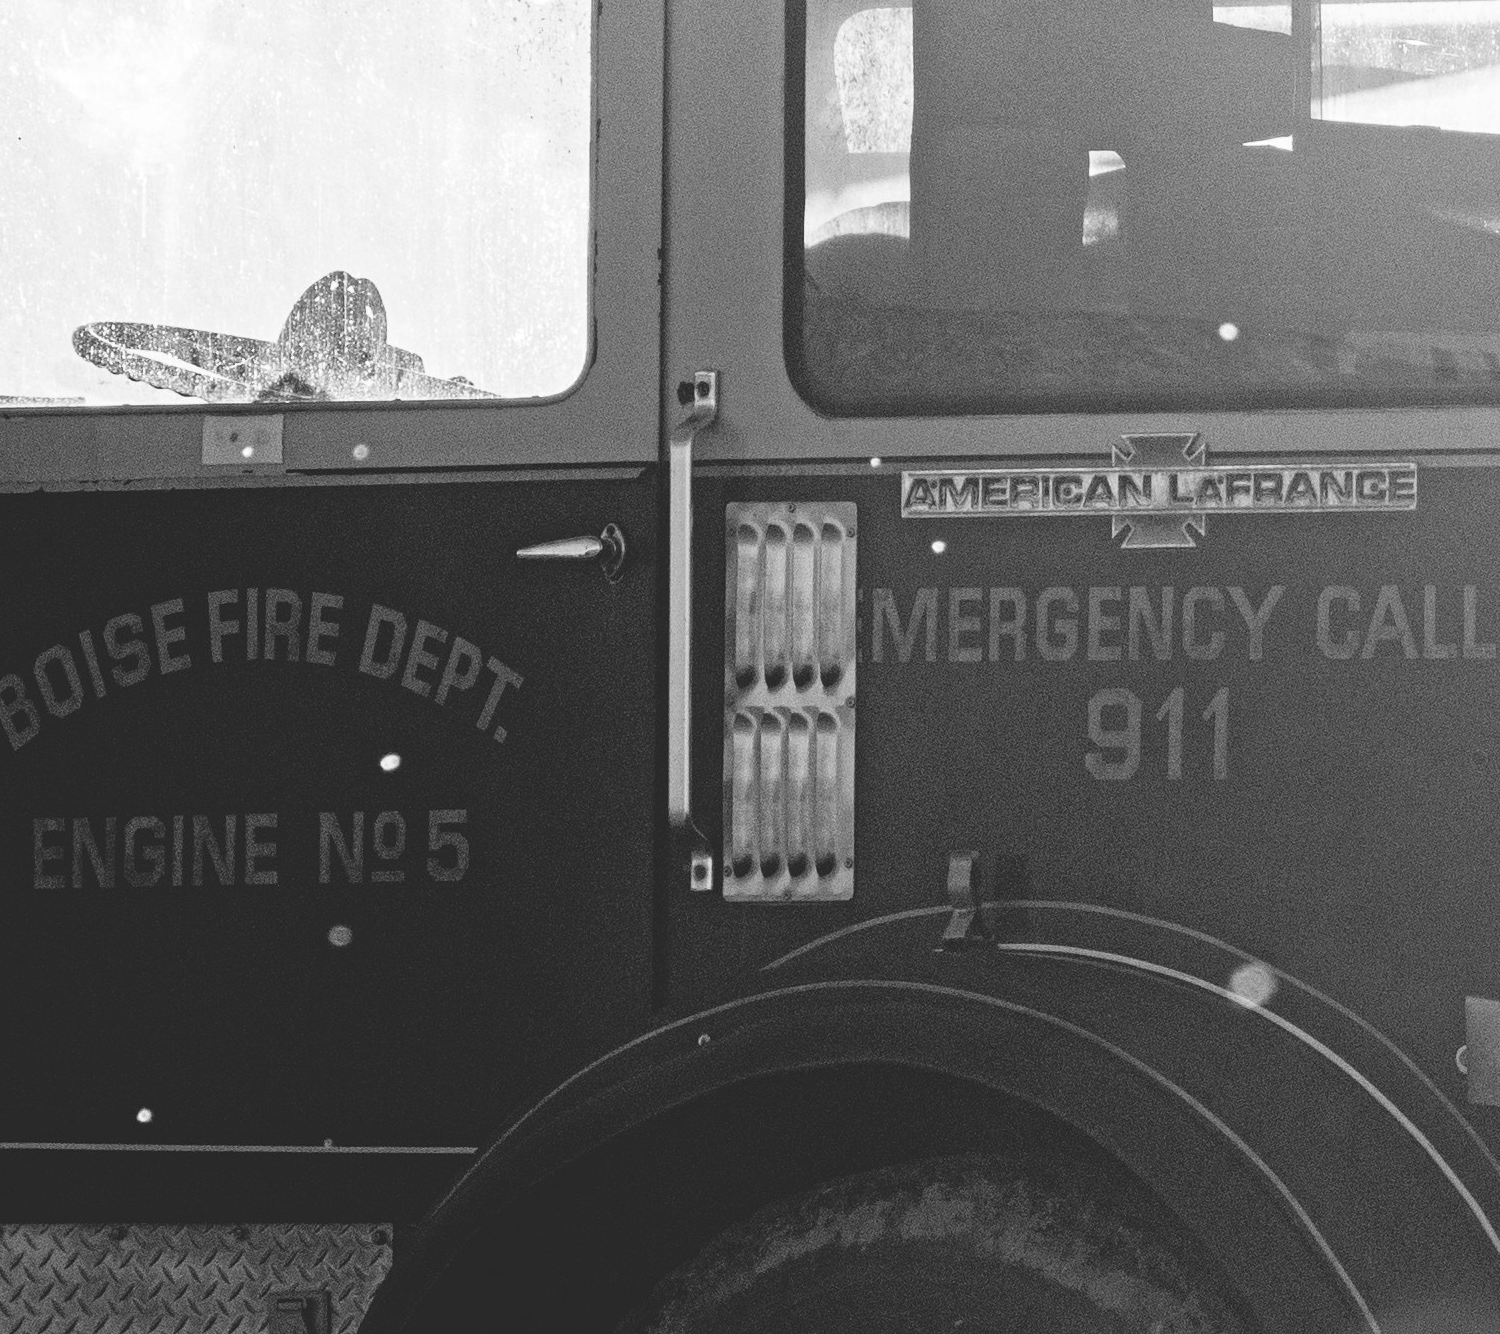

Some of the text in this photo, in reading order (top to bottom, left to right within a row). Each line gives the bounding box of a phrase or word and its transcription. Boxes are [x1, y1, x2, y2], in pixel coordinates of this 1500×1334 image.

[904, 472, 1153, 511] AMERICAN
[856, 584, 1498, 664] MERGENCY CALL
[207, 587, 344, 666] FIRE
[358, 603, 524, 743] DEPT.
[1084, 687, 1229, 781] 911
[32, 812, 279, 889] ENGINE
[426, 809, 470, 883] 5
